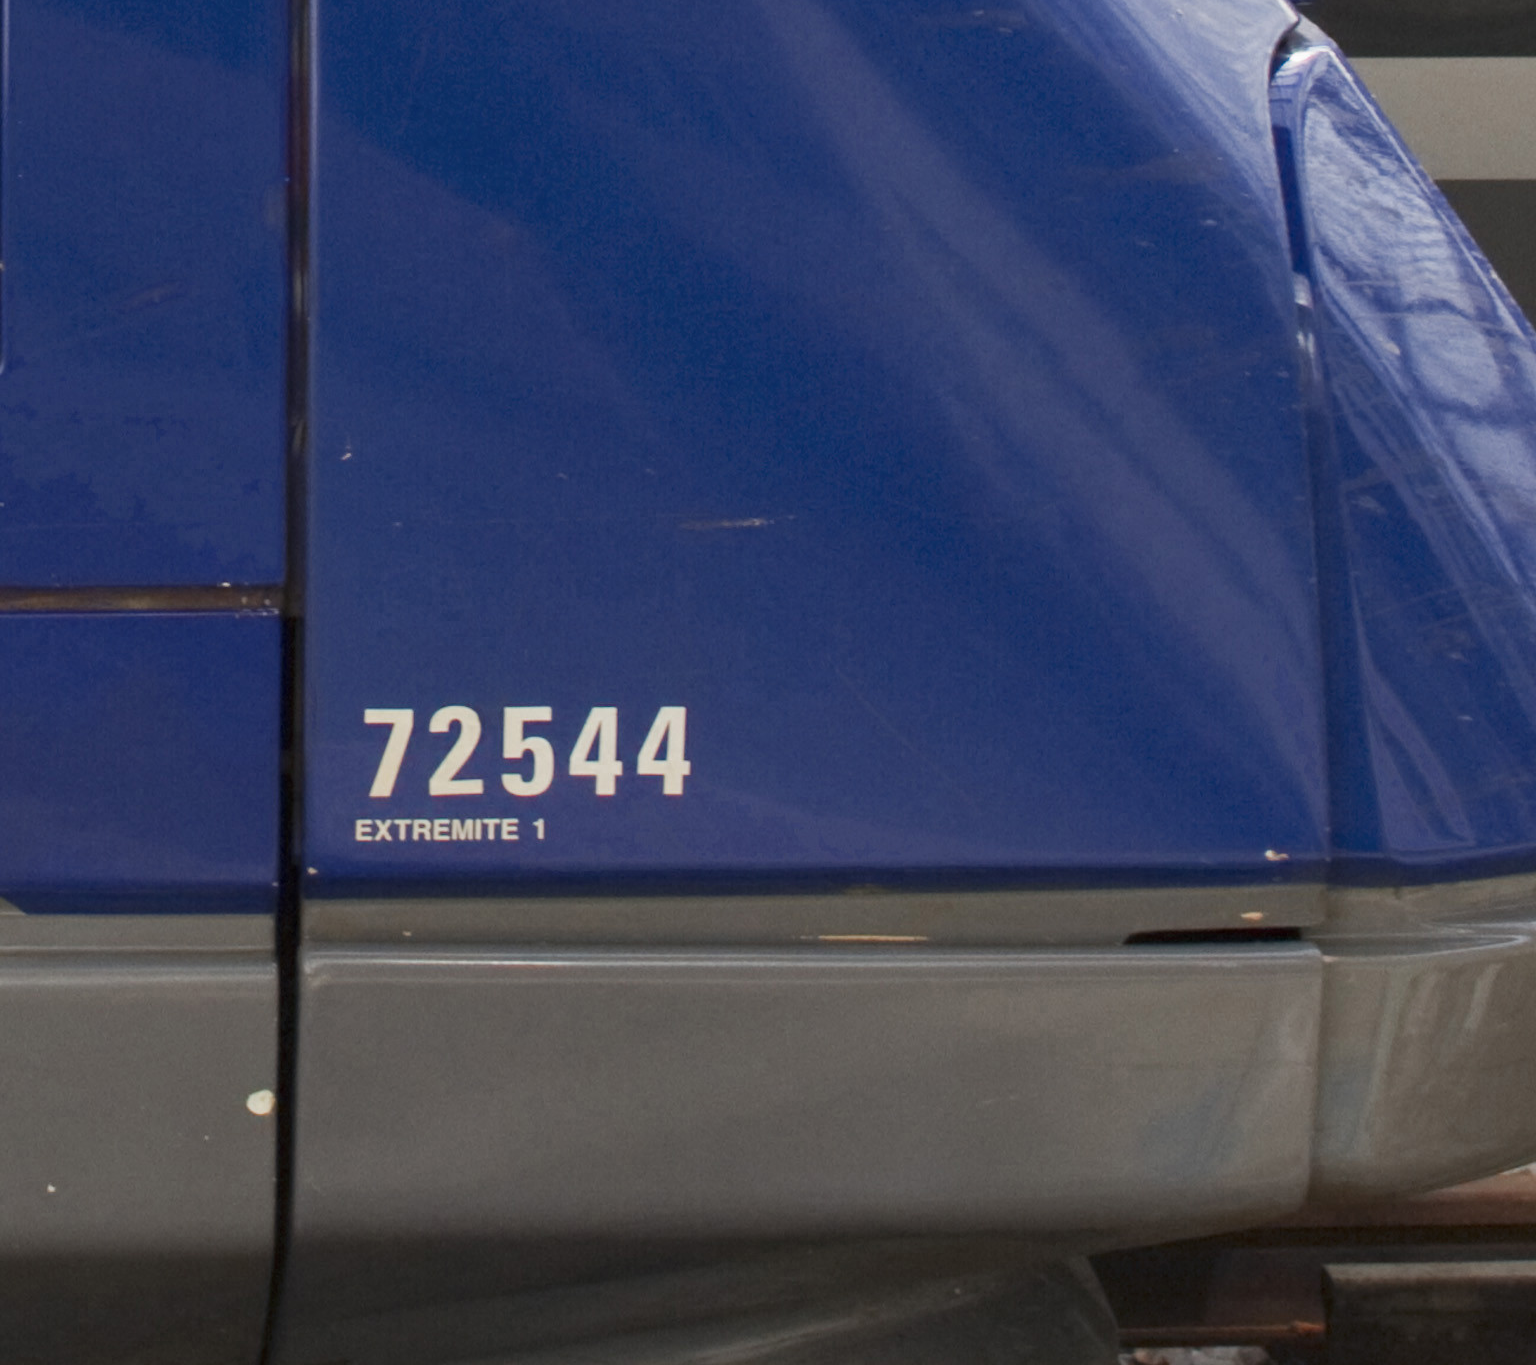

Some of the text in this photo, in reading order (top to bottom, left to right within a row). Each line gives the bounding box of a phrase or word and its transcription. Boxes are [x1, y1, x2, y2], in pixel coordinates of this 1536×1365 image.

[363, 705, 692, 798] 72544
[354, 818, 546, 842] EXTREMITE 1
